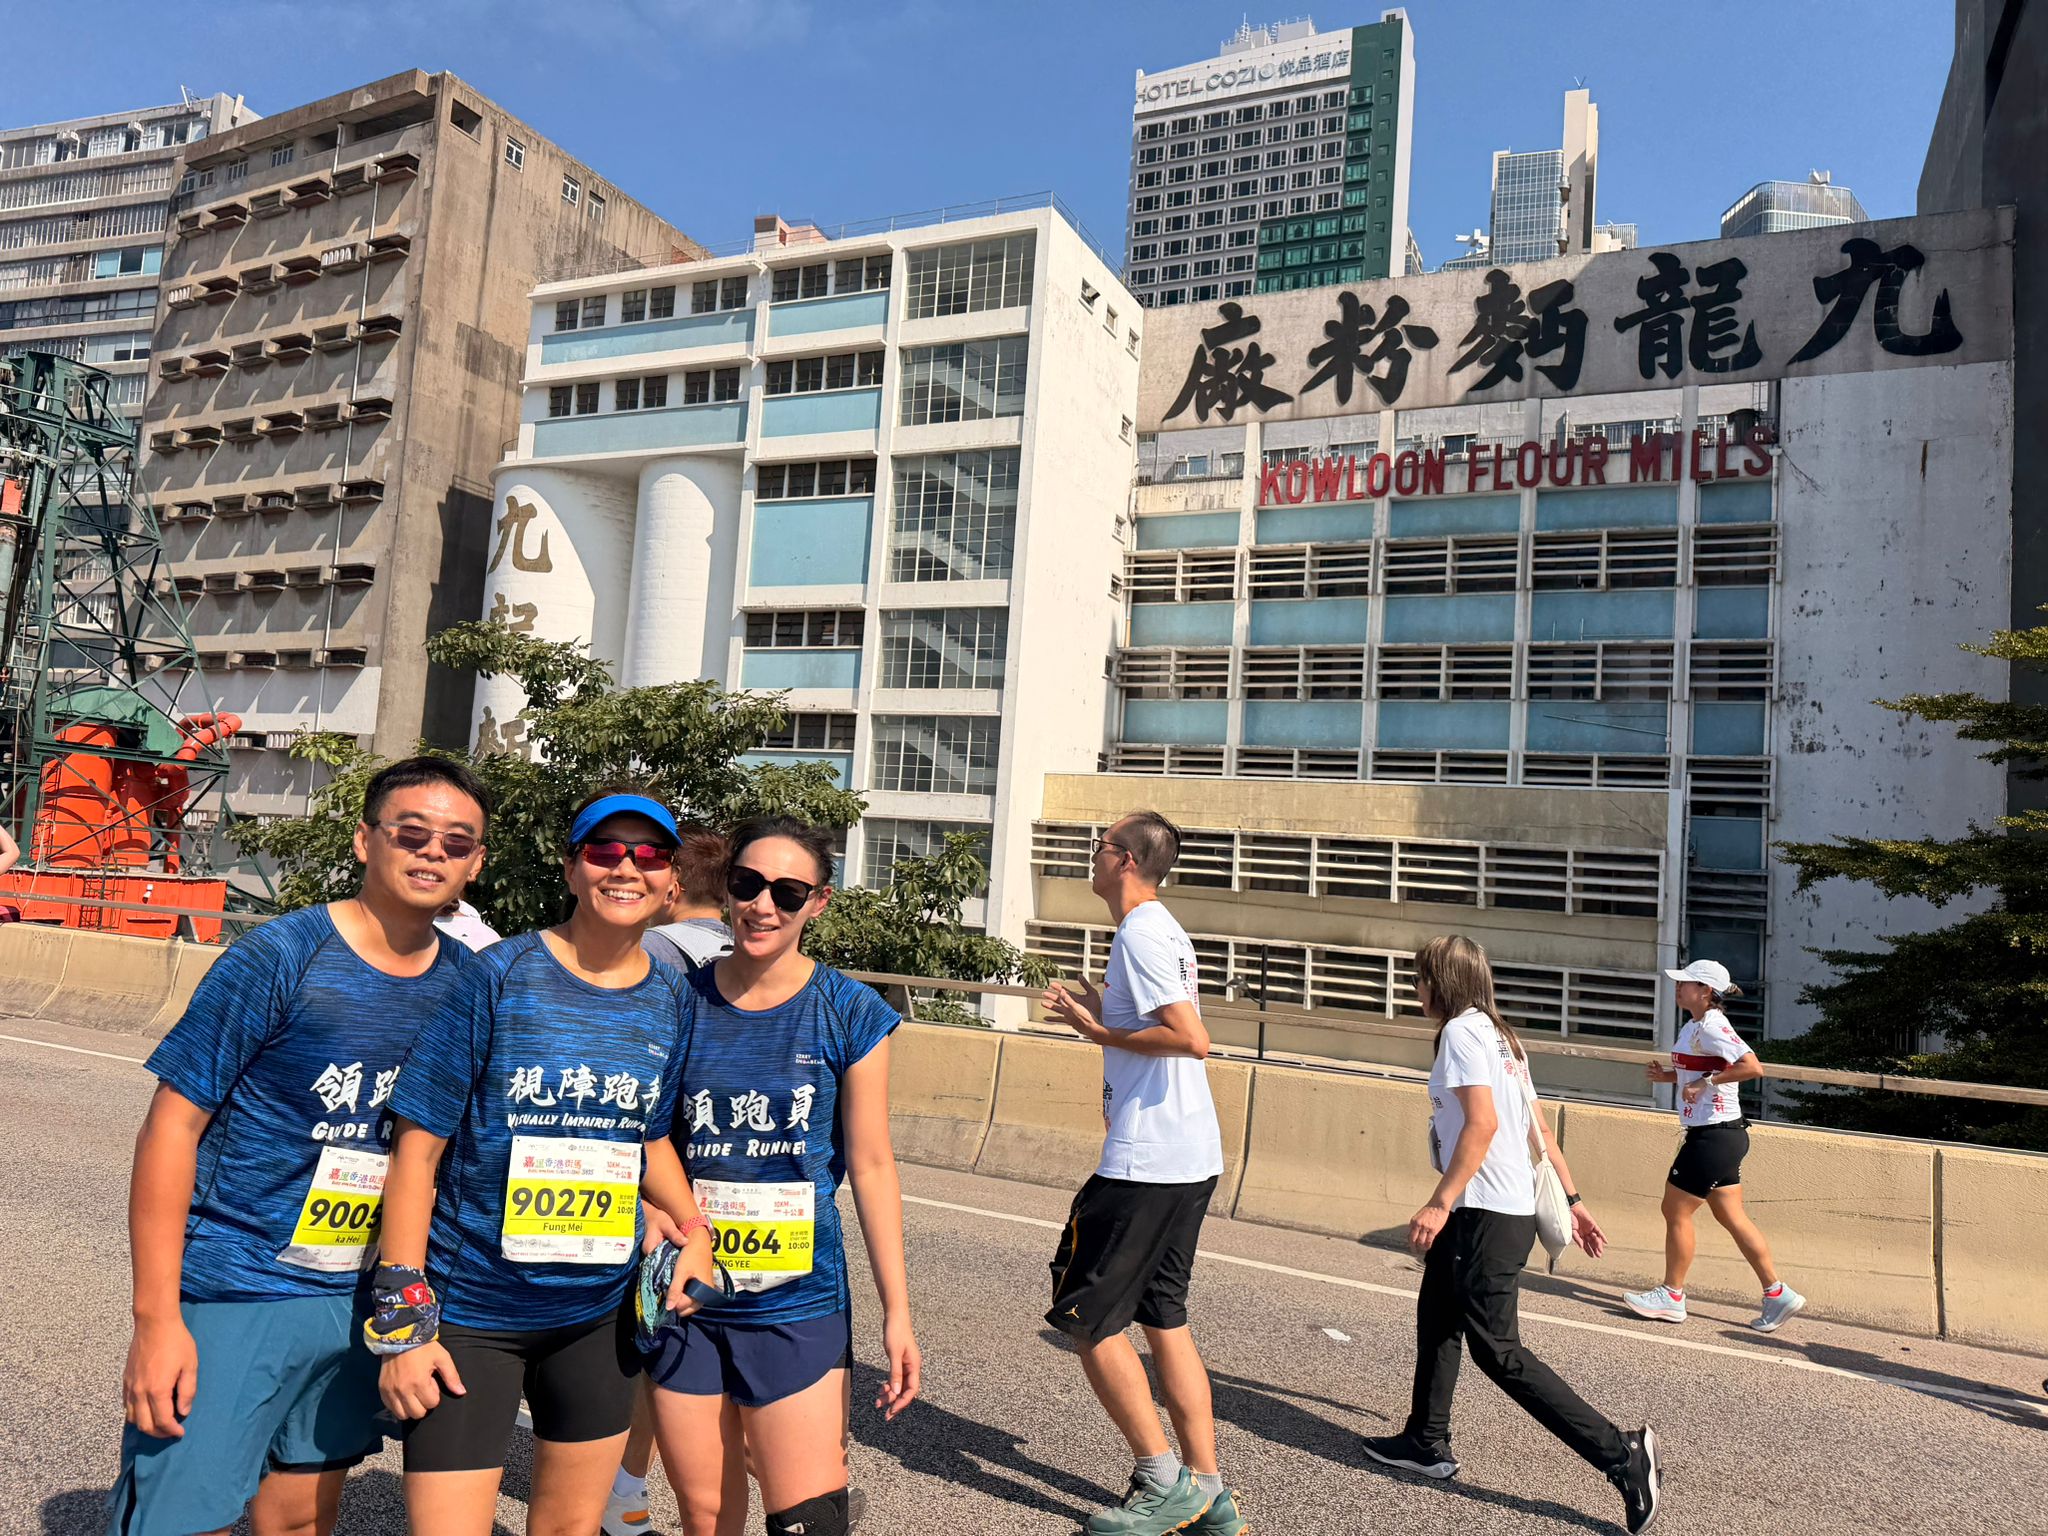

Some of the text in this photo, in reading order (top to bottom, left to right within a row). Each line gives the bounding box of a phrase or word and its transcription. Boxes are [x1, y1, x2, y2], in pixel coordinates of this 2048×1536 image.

[1137, 76, 1203, 104] HOTEL
[1260, 425, 1774, 505] KOWLOON FLOUR MILLS
[507, 1063, 661, 1114] 視障跑手
[507, 1113, 559, 1127] VISUALLY
[562, 1112, 616, 1128] IMPAIRED
[512, 1187, 612, 1218] 90279
[543, 1222, 583, 1233] Fung Mei
[788, 1242, 810, 1250] 10:00
[735, 1260, 750, 1269] YEE
